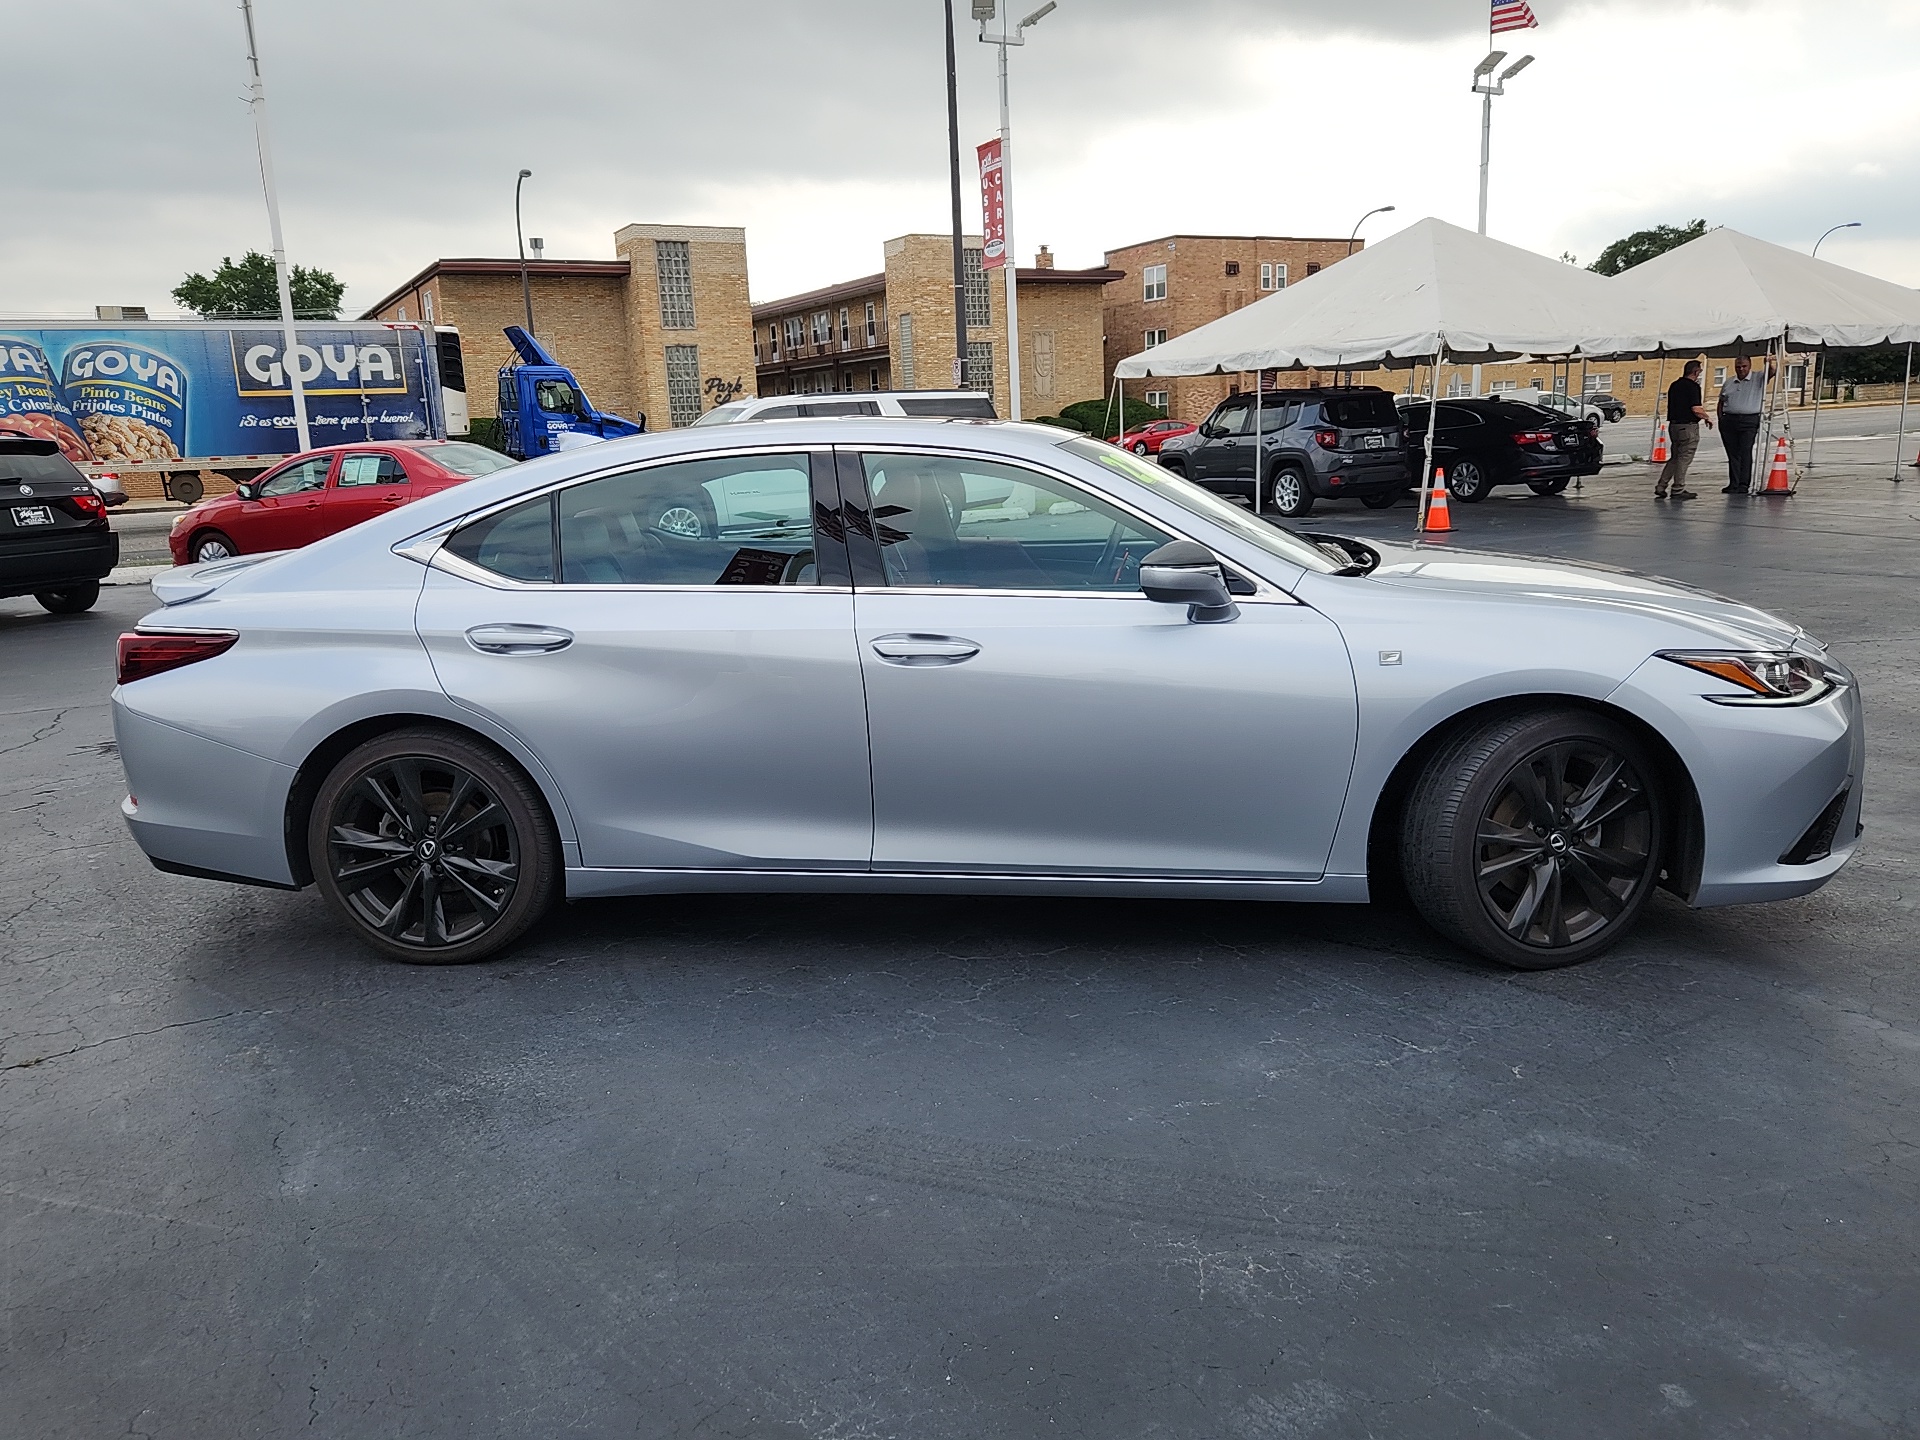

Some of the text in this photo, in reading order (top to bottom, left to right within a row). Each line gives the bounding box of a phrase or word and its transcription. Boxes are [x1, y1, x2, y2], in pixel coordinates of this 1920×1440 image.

[982, 178, 991, 240] USED
[995, 172, 1003, 237] CARS
[71, 350, 179, 398] GOYA
[244, 344, 395, 387] GOYA
[80, 387, 167, 412] Pinto Beans
[704, 376, 742, 395] Park
[72, 399, 173, 428] Frijoles Pintos
[258, 418, 272, 427] es
[341, 415, 360, 431] que
[360, 415, 379, 424] ser
[380, 409, 414, 423] bueno!
[547, 422, 569, 430] GOYA
